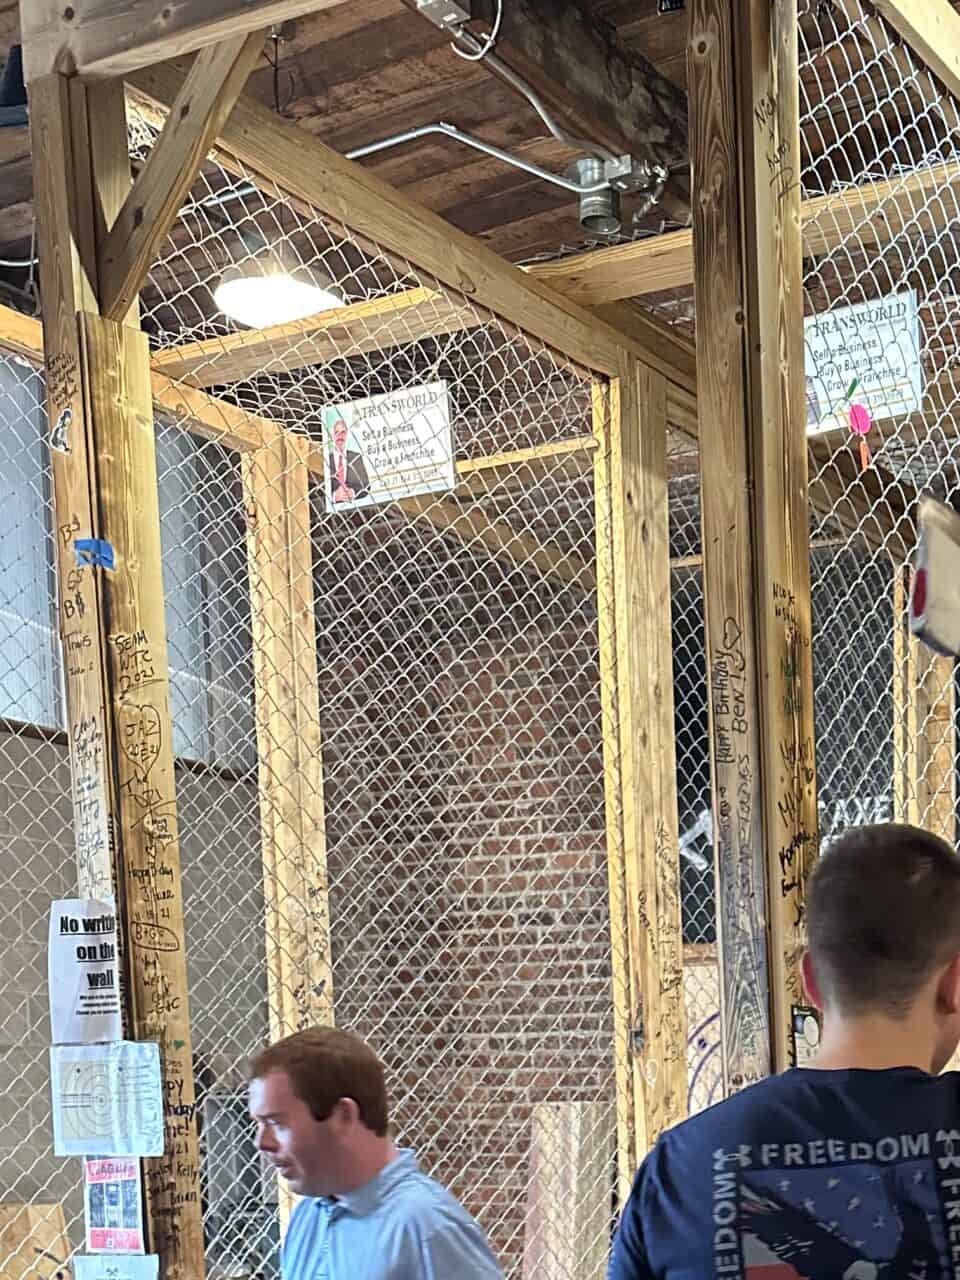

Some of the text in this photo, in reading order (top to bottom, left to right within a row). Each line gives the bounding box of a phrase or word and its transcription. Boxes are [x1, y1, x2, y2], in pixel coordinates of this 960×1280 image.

[60, 914, 115, 933] No writi
[76, 945, 97, 960] on
[87, 969, 114, 986] wall
[761, 1132, 930, 1167] FREEDOM
